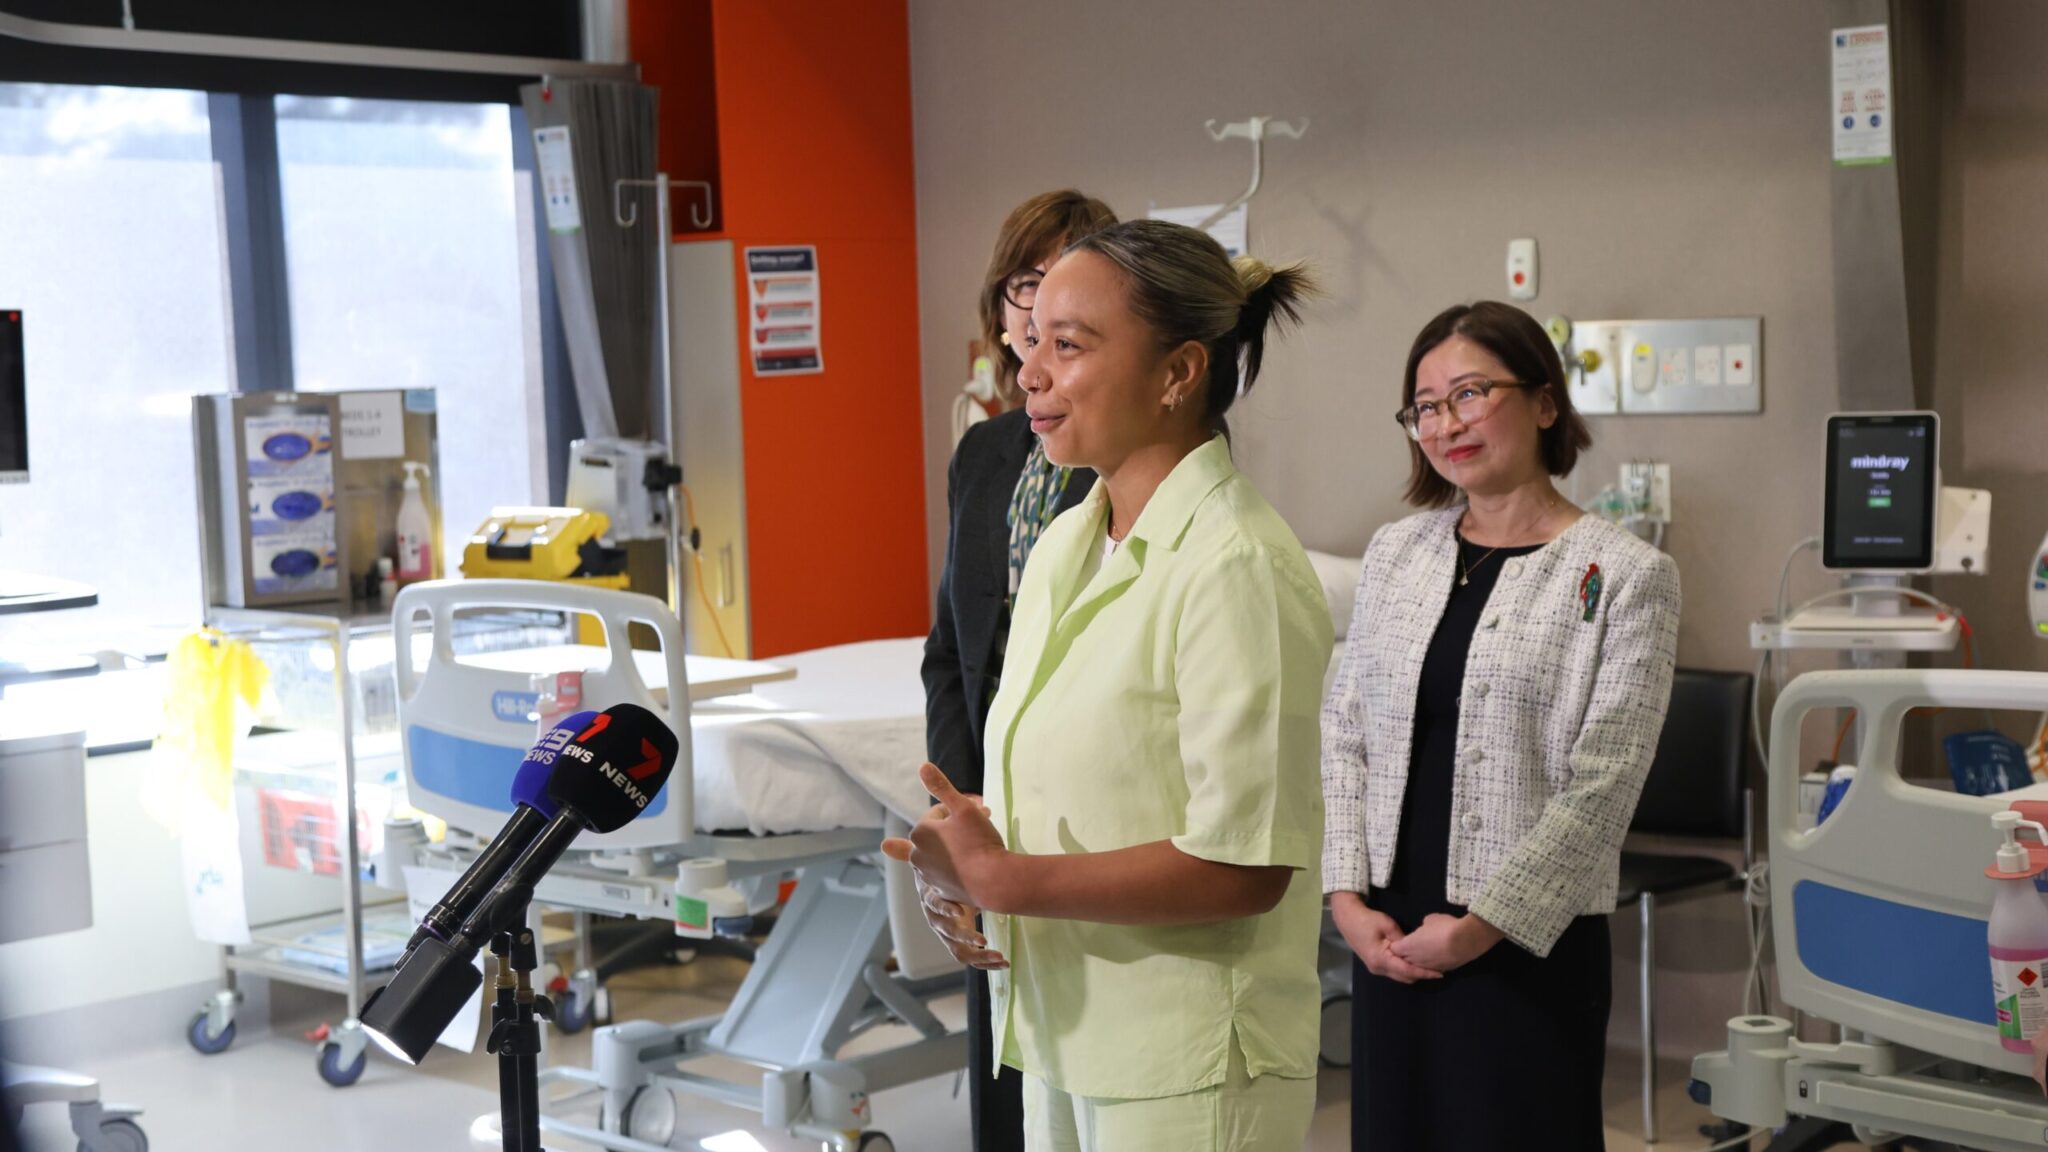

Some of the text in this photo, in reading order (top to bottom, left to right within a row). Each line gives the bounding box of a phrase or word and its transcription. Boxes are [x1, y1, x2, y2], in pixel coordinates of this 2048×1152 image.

[1851, 455, 1910, 471] mindray
[496, 696, 537, 714] Hill-Ro
[524, 748, 557, 765] EWS
[561, 744, 595, 763] EWS
[599, 761, 649, 809] NEWS
